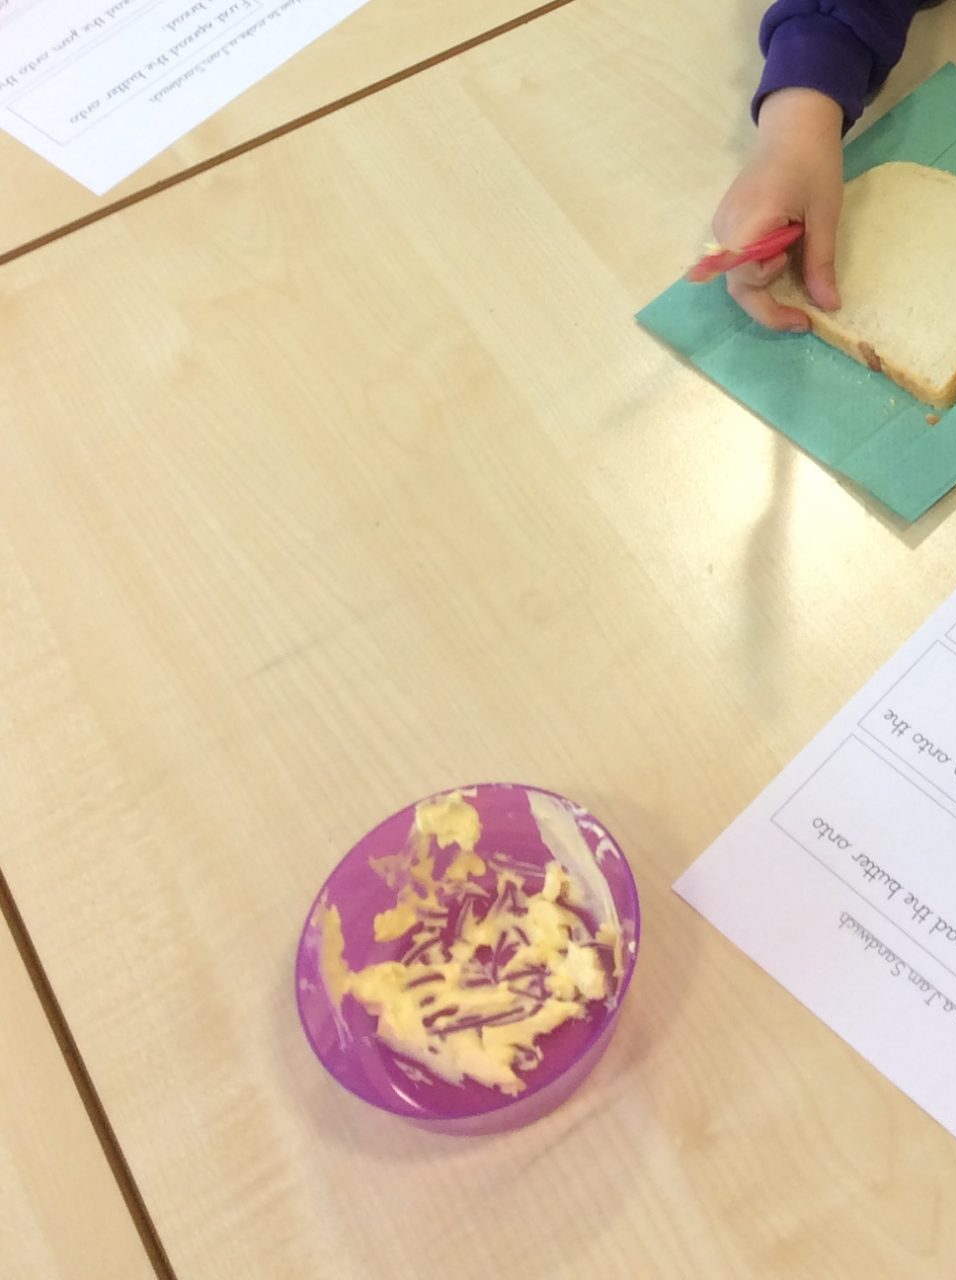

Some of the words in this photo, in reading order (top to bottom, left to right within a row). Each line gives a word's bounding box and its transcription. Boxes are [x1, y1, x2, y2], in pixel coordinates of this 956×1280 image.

[882, 707, 912, 738] the
[910, 731, 953, 764] onto
[810, 815, 853, 850] onto
[849, 851, 904, 901] butter
[902, 890, 934, 925] the
[836, 909, 910, 978] Sandwich
[906, 966, 946, 1007] Jam
